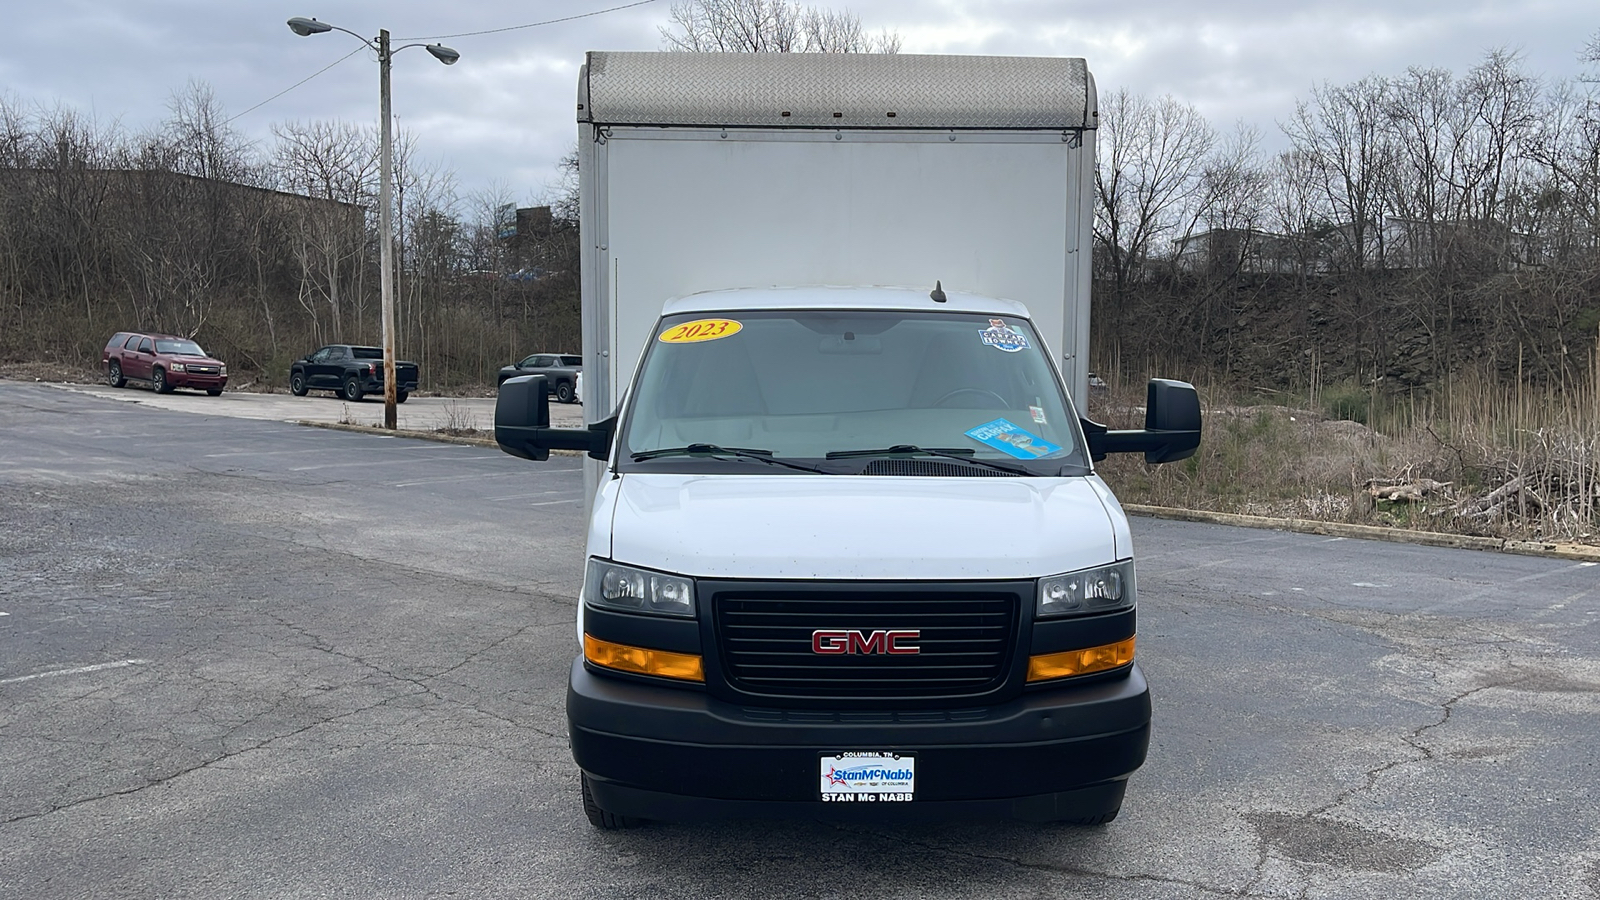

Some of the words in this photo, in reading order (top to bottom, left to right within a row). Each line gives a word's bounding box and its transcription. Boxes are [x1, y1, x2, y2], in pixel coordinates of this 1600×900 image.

[671, 322, 729, 340] 2023
[976, 423, 1018, 440] CARFAX
[812, 629, 920, 654] GMC
[834, 769, 912, 780] StanMcNabb
[821, 793, 855, 802] STAN
[858, 793, 876, 802] Mc
[879, 793, 913, 802] NABB
